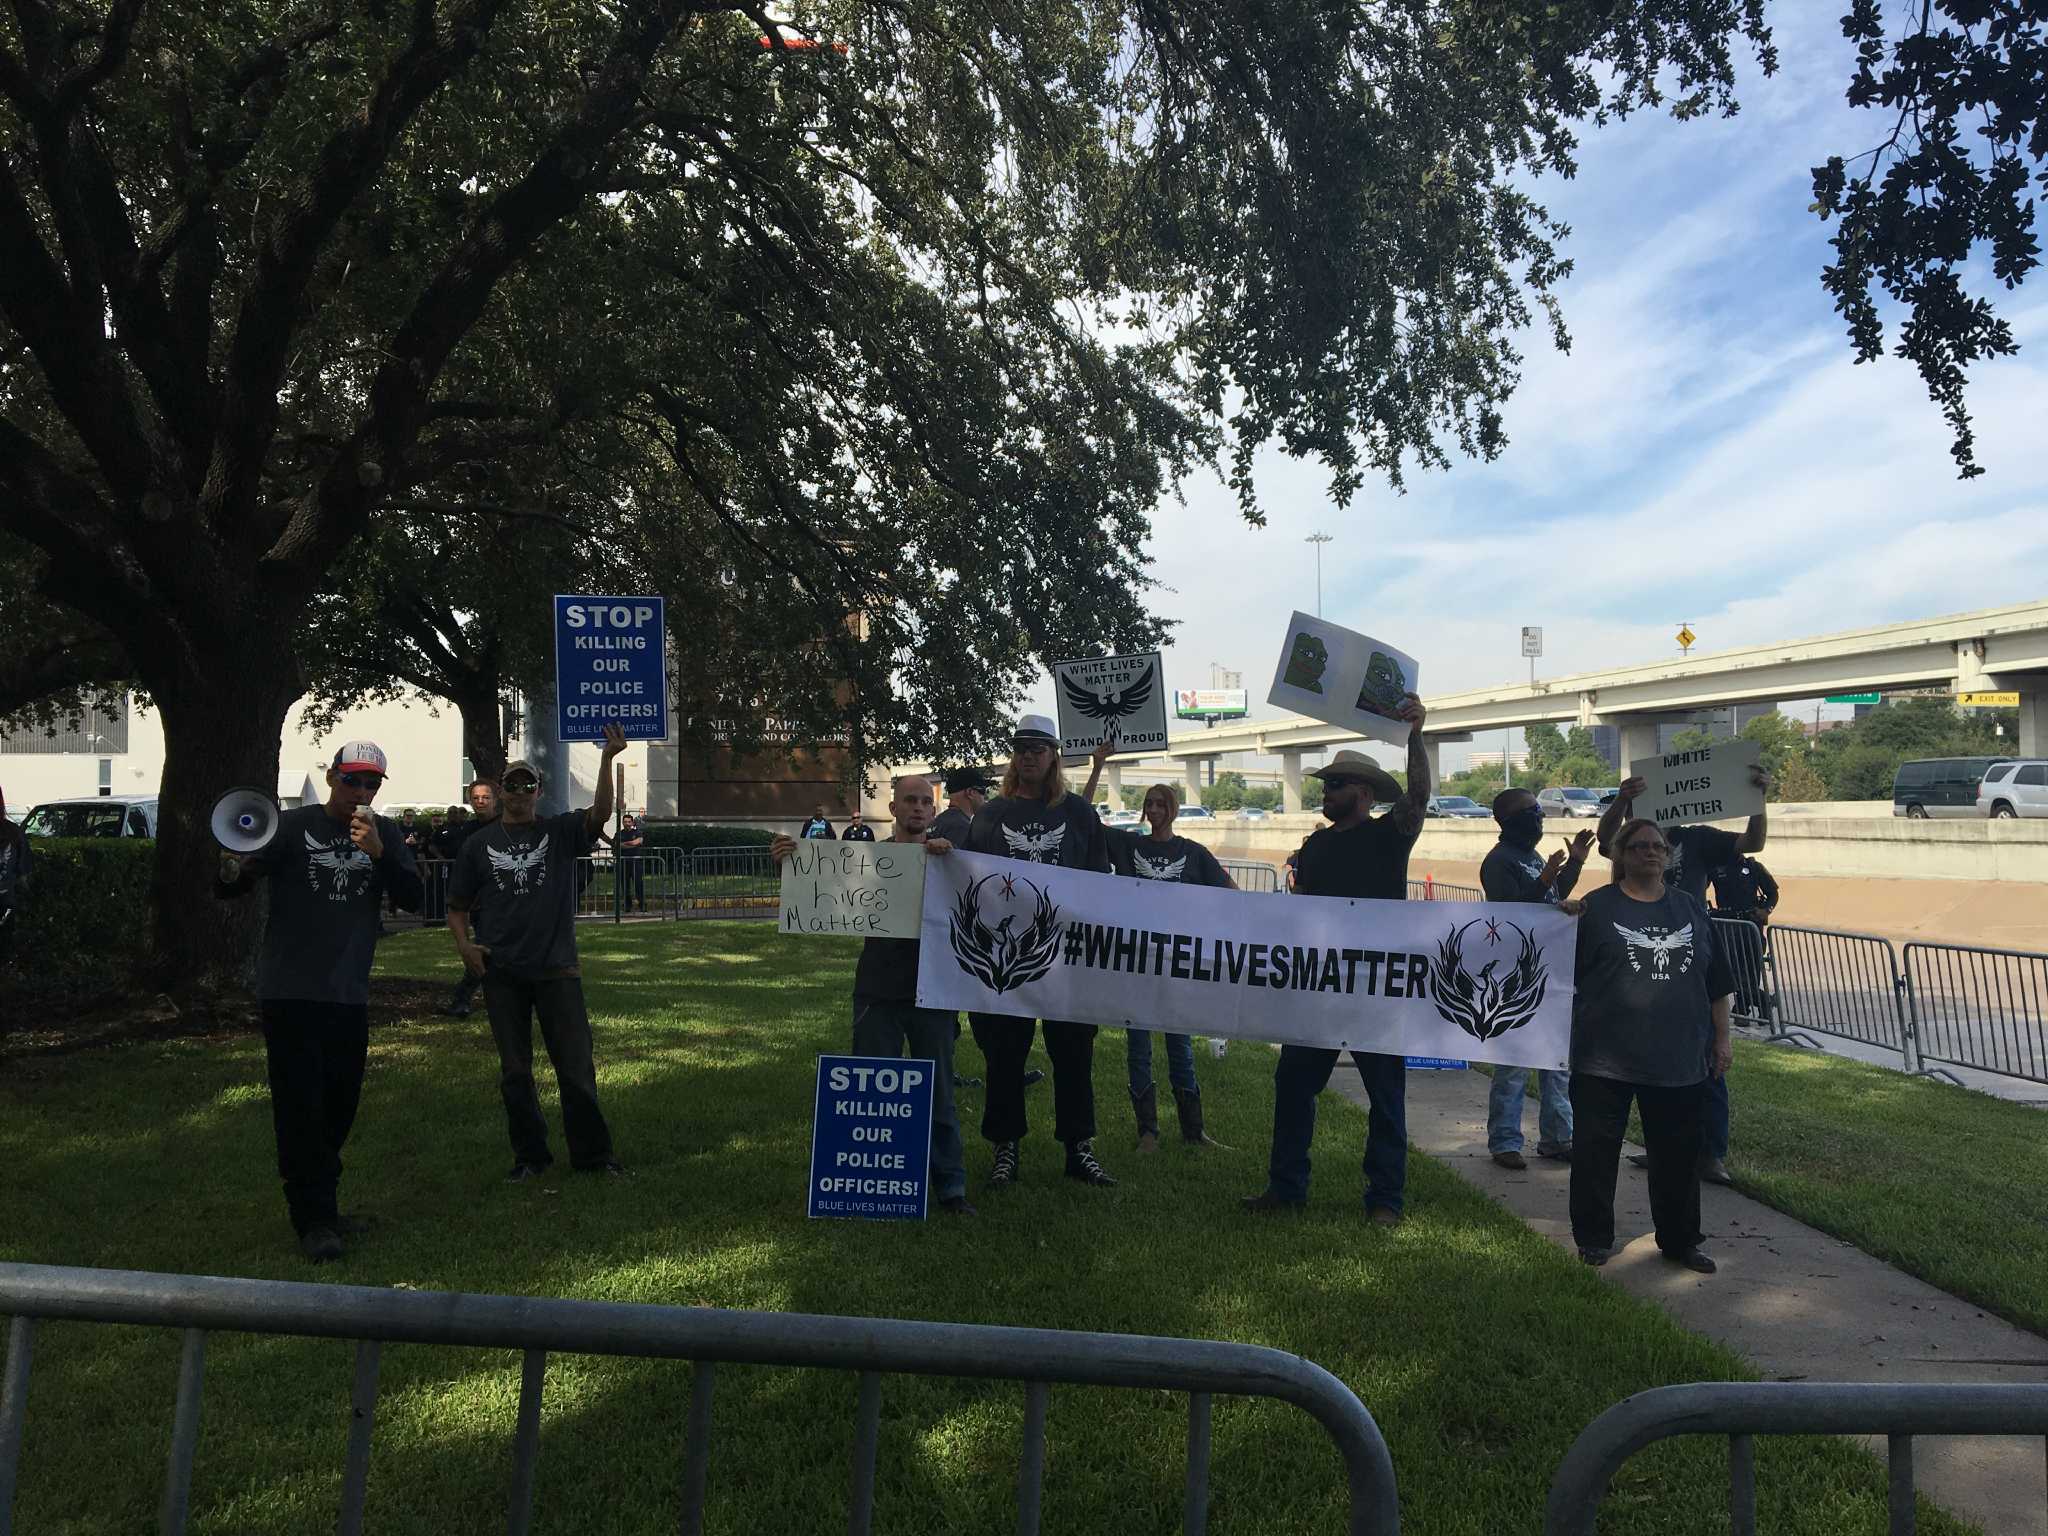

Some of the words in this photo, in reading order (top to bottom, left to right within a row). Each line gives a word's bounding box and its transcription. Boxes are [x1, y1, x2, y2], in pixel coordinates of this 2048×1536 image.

[566, 605, 653, 628] STOP
[575, 636, 646, 649] KILLING
[592, 659, 630, 672] OUR
[1070, 663, 1106, 674] WHITE
[1111, 659, 1144, 671] LIVES
[1085, 673, 1130, 685] MATTER
[580, 681, 644, 694] POLICE
[566, 704, 658, 718] OFFICERS!
[567, 725, 591, 733] BLUE
[1066, 737, 1104, 748] STAND
[1123, 732, 1164, 744] PROUD
[1665, 776, 1711, 795] LIVES
[1655, 800, 1723, 821] MATTER
[791, 842, 903, 878] White
[1639, 926, 1669, 934] IVES
[1064, 921, 1430, 999] #WHITELIVESMATTER
[829, 1067, 923, 1094] STOP
[835, 1101, 912, 1118] KILLING
[852, 1127, 892, 1142] OUR
[836, 1152, 905, 1169] POLICE
[819, 1177, 919, 1196] OFFICERS!
[818, 1200, 844, 1210] BLUE
[846, 1202, 875, 1212] LIVES
[877, 1204, 917, 1214] MATTER
